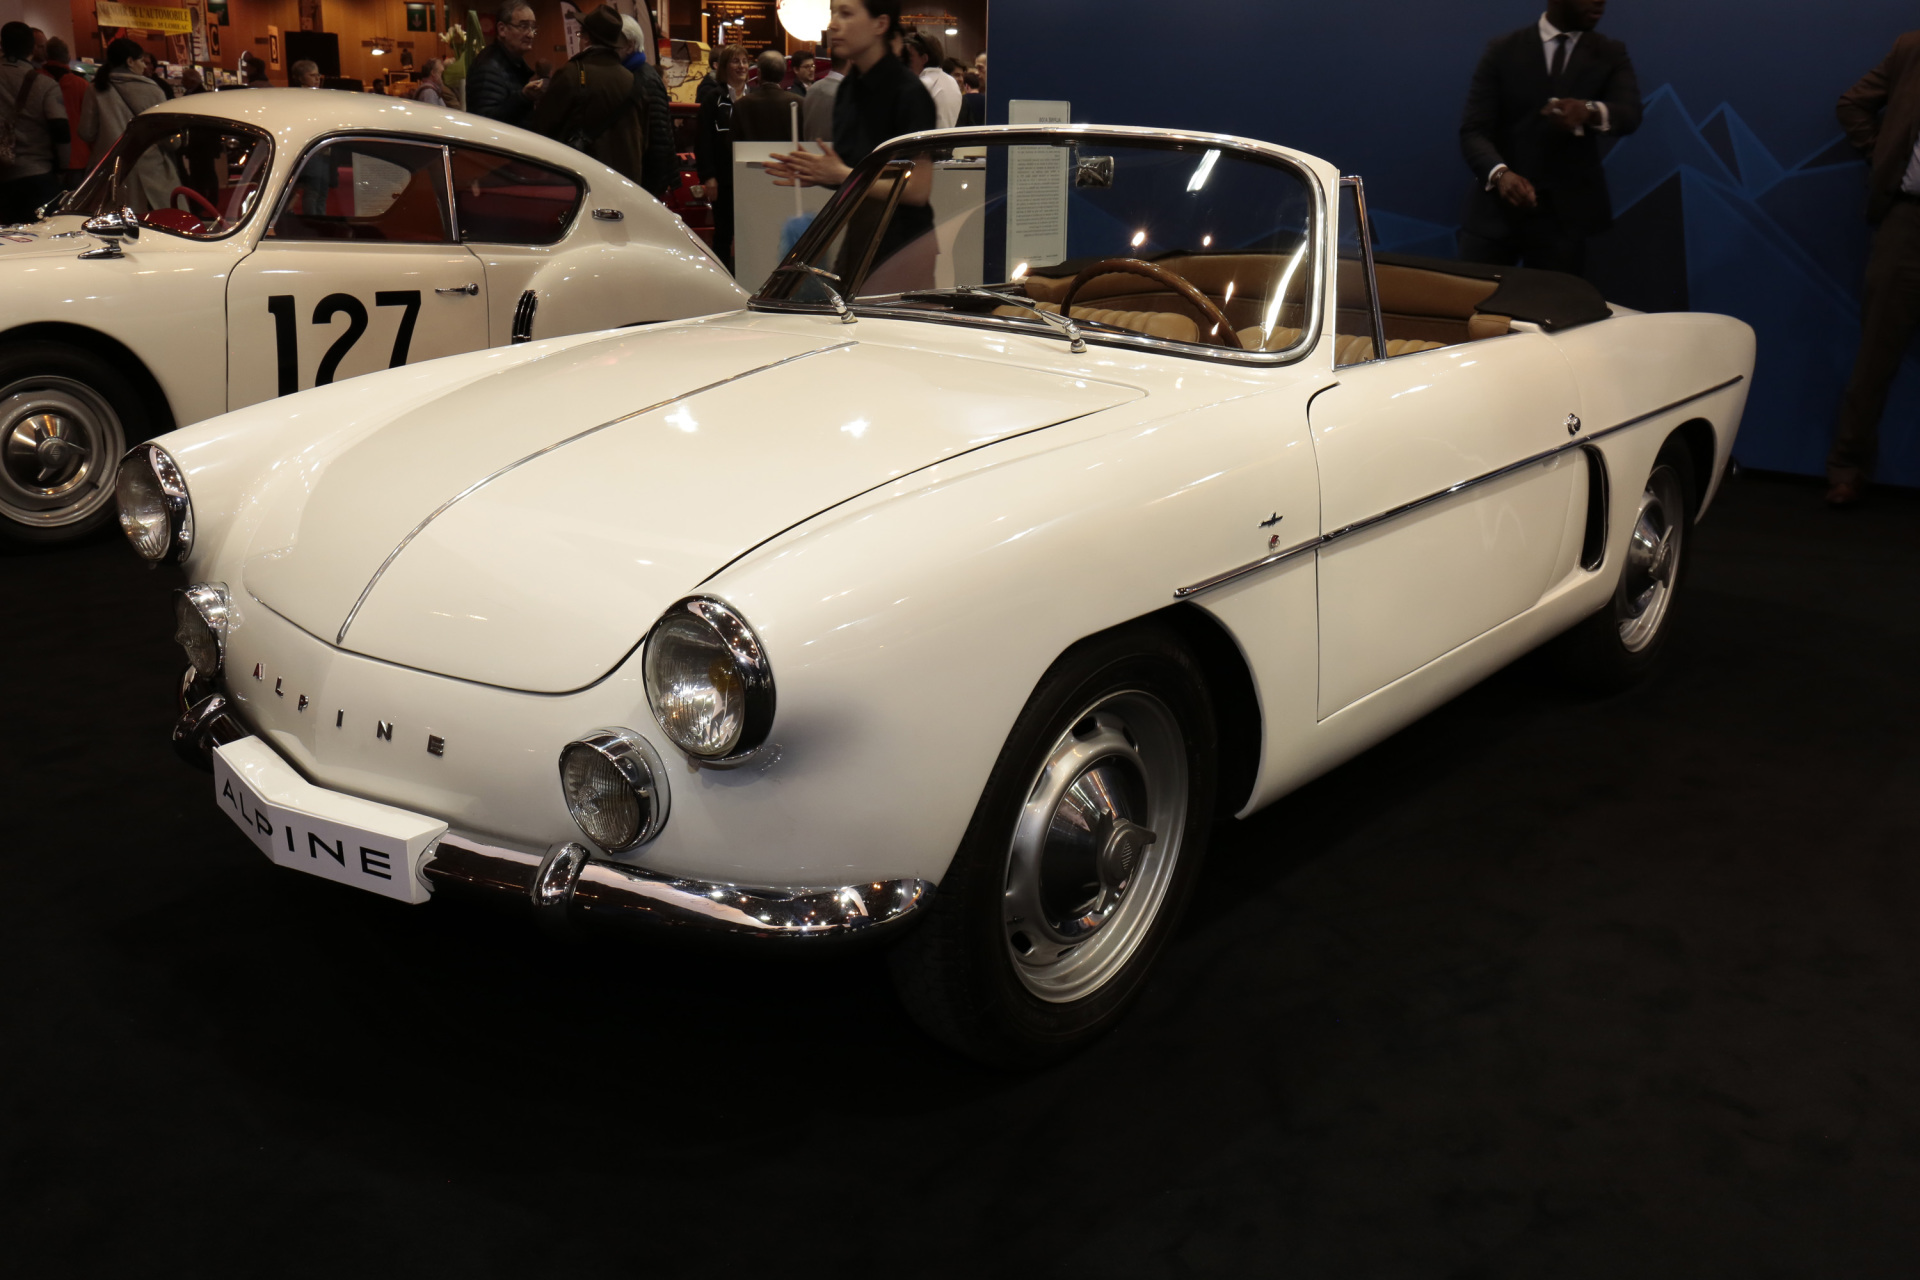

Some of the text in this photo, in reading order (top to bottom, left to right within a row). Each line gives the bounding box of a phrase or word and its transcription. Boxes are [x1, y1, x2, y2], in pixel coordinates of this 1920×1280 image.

[139, 7, 189, 21] L'AUTOMOBILE
[268, 289, 421, 398] 127
[252, 662, 446, 757] ALPINE
[222, 778, 392, 881] ALPINE
